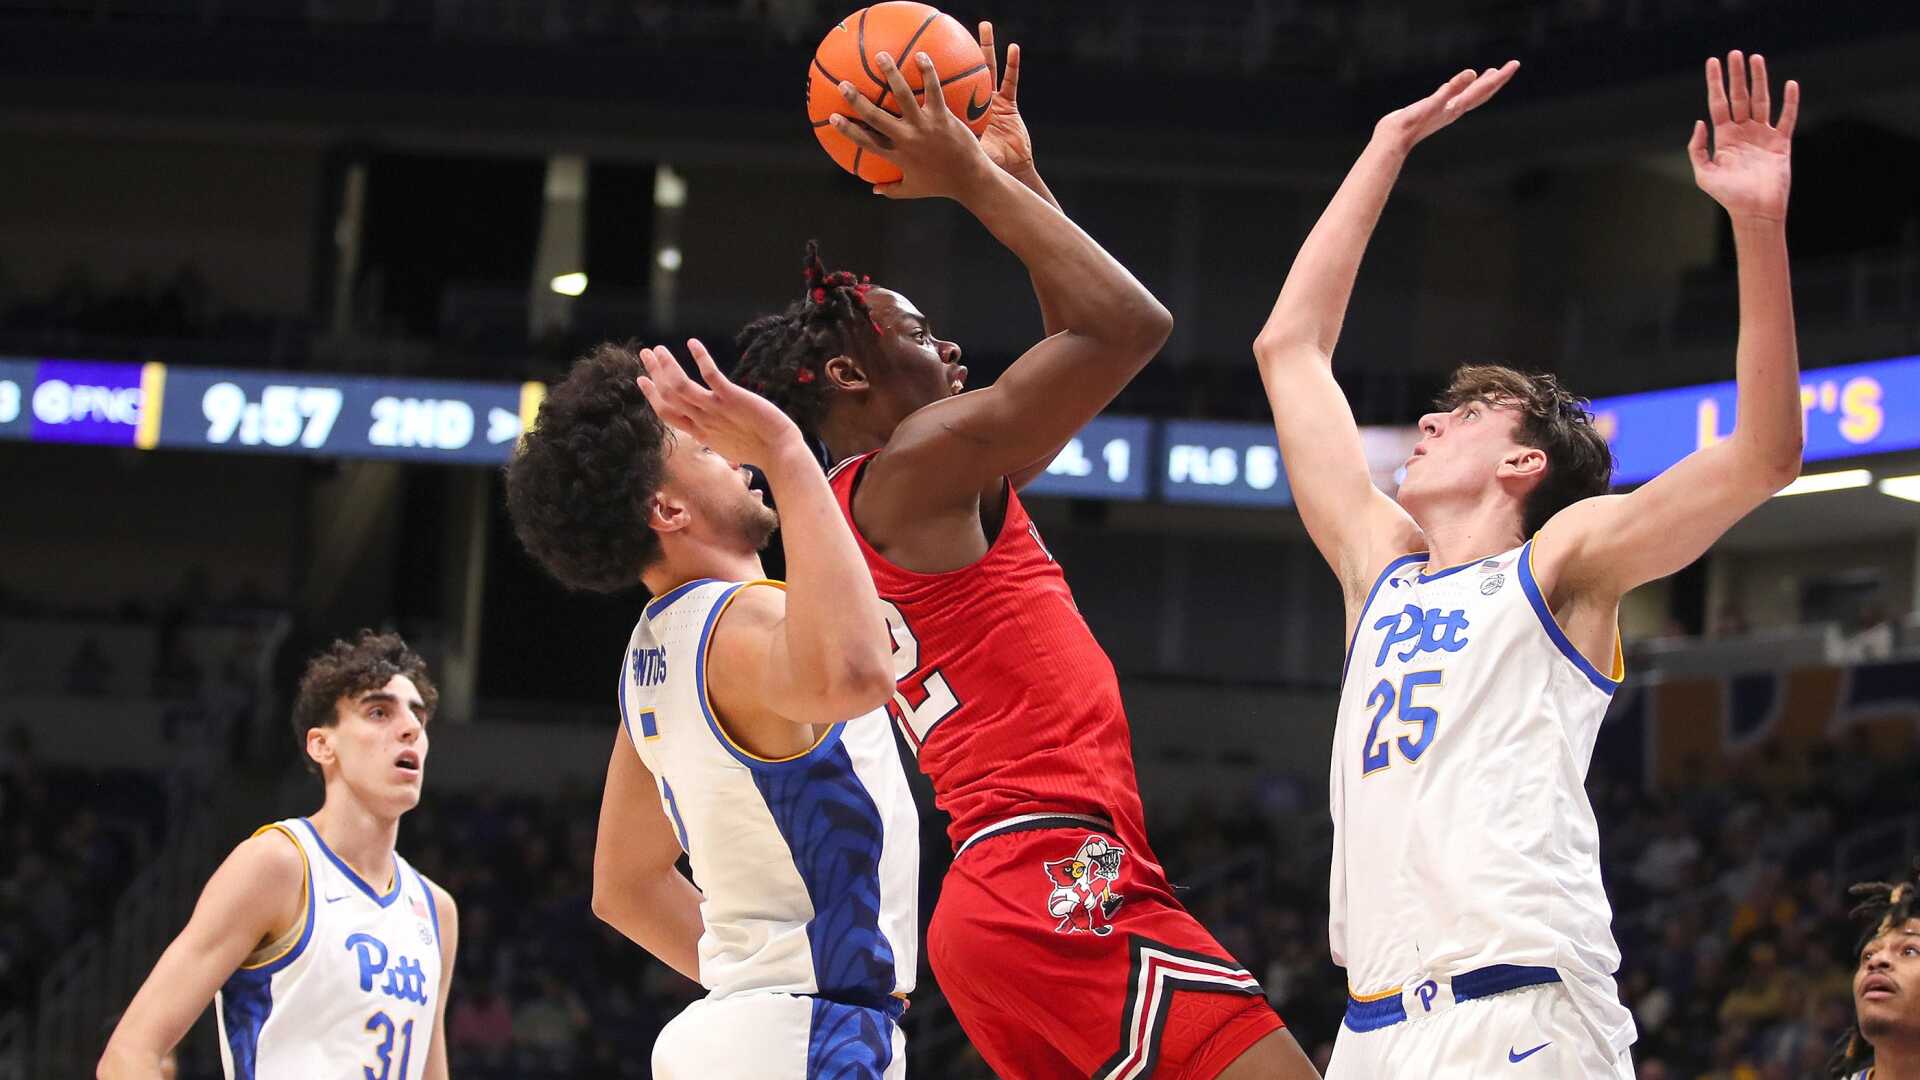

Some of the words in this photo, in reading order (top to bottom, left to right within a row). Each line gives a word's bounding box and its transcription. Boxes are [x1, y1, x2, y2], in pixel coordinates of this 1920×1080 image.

[202, 382, 343, 448] 9:57
[368, 396, 474, 450] 2ND
[1103, 438, 1130, 483] 1
[1362, 669, 1444, 779] 25
[345, 932, 428, 1006] Pitt
[363, 1010, 415, 1080] 31
